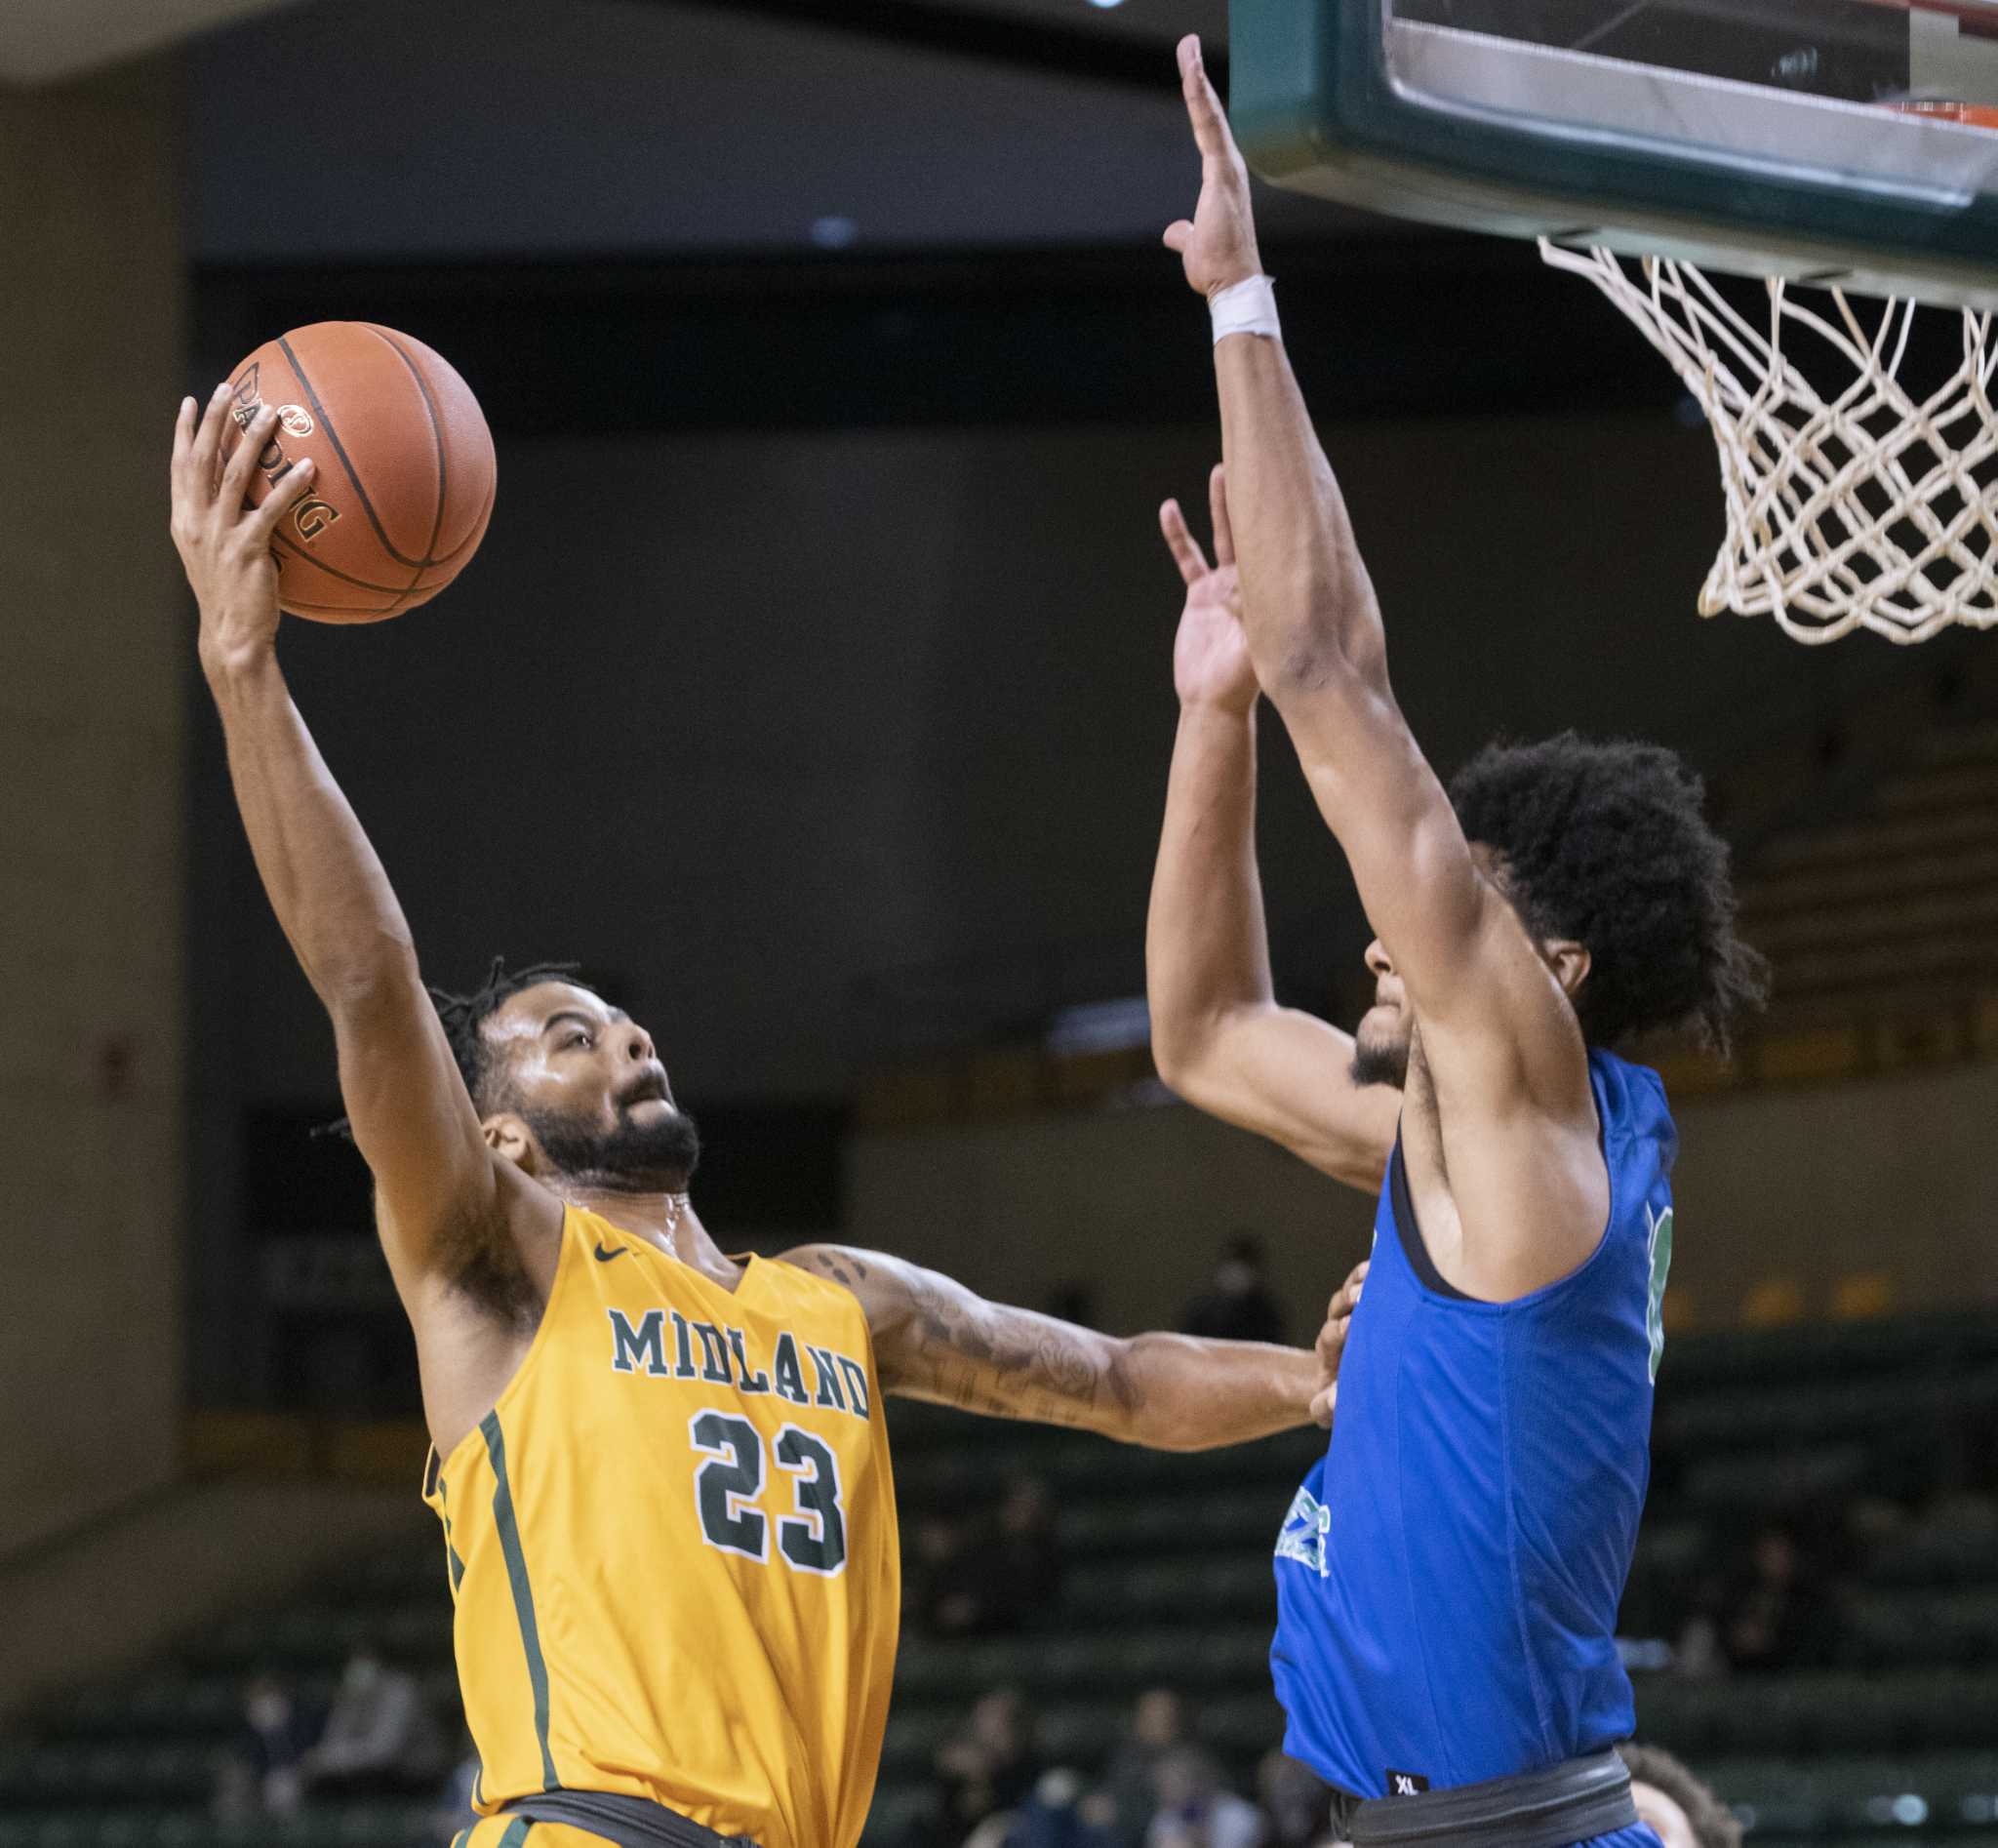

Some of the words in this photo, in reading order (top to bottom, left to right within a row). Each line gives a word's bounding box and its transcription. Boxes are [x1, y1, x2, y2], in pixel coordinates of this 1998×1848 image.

[607, 1308, 869, 1421] MIDLAND
[688, 1408, 847, 1578] 23
[1395, 1775, 1419, 1795] XL
